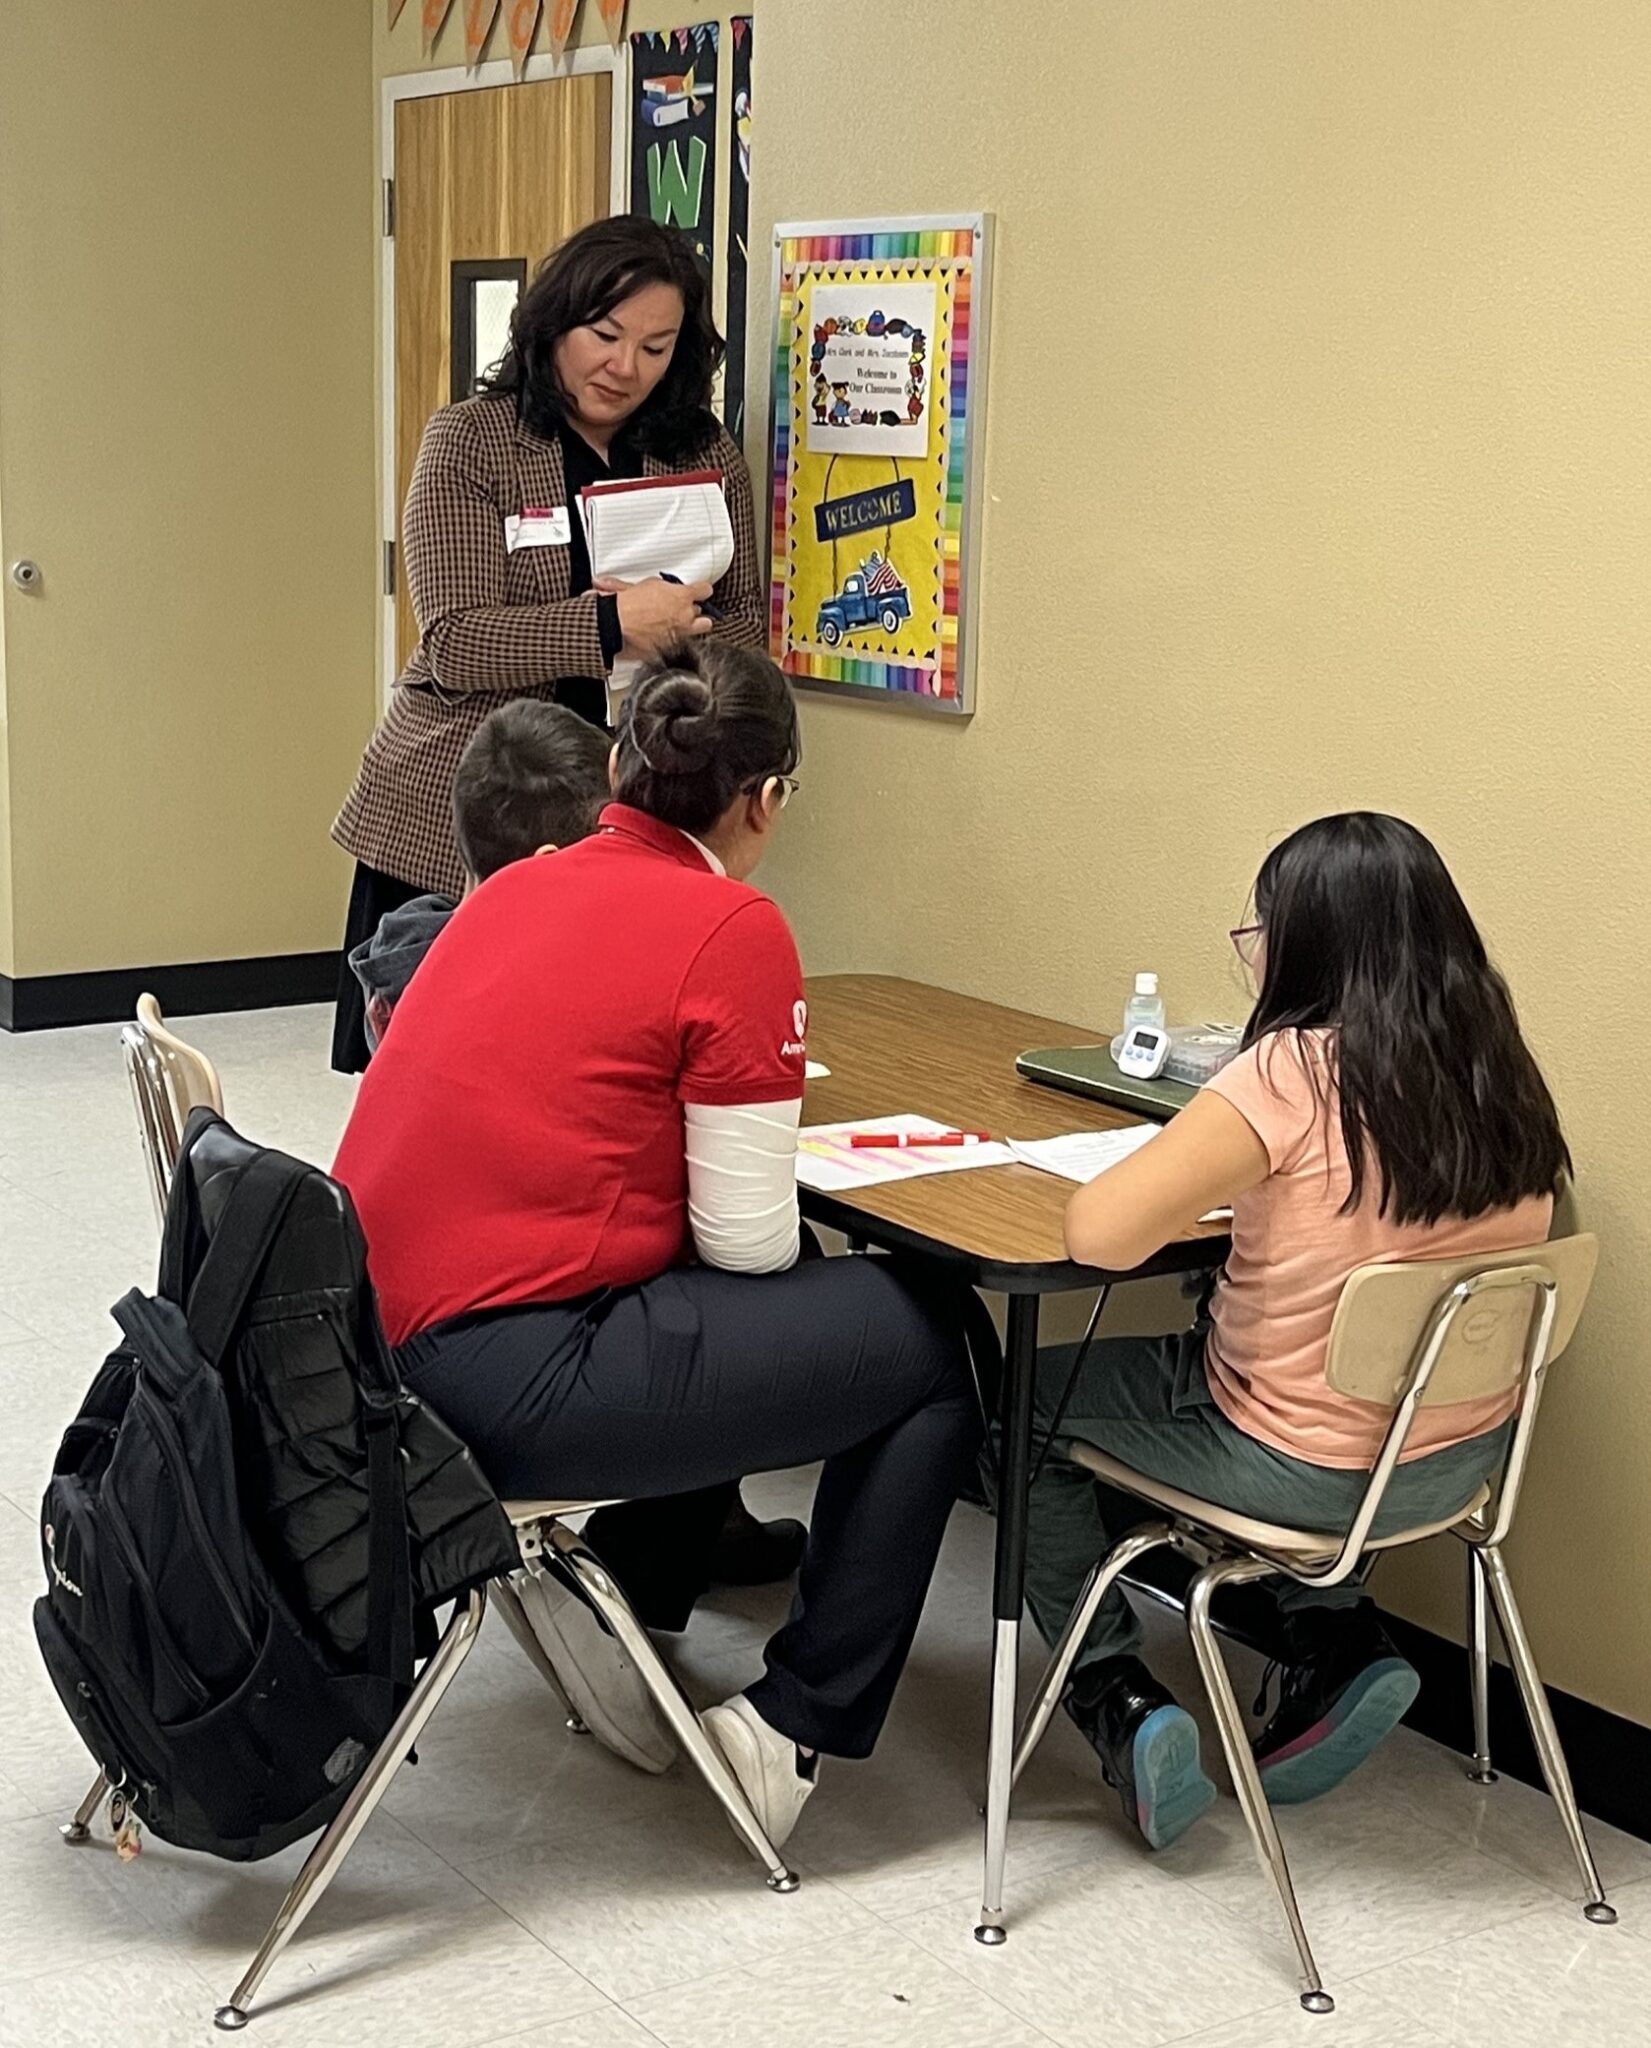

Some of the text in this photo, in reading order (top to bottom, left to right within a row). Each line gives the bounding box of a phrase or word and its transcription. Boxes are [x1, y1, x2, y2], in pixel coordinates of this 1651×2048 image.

[646, 136, 707, 230] W
[857, 367, 897, 379] Welcome to
[849, 382, 902, 394] Our Classroom
[825, 490, 902, 531] WELCOME
